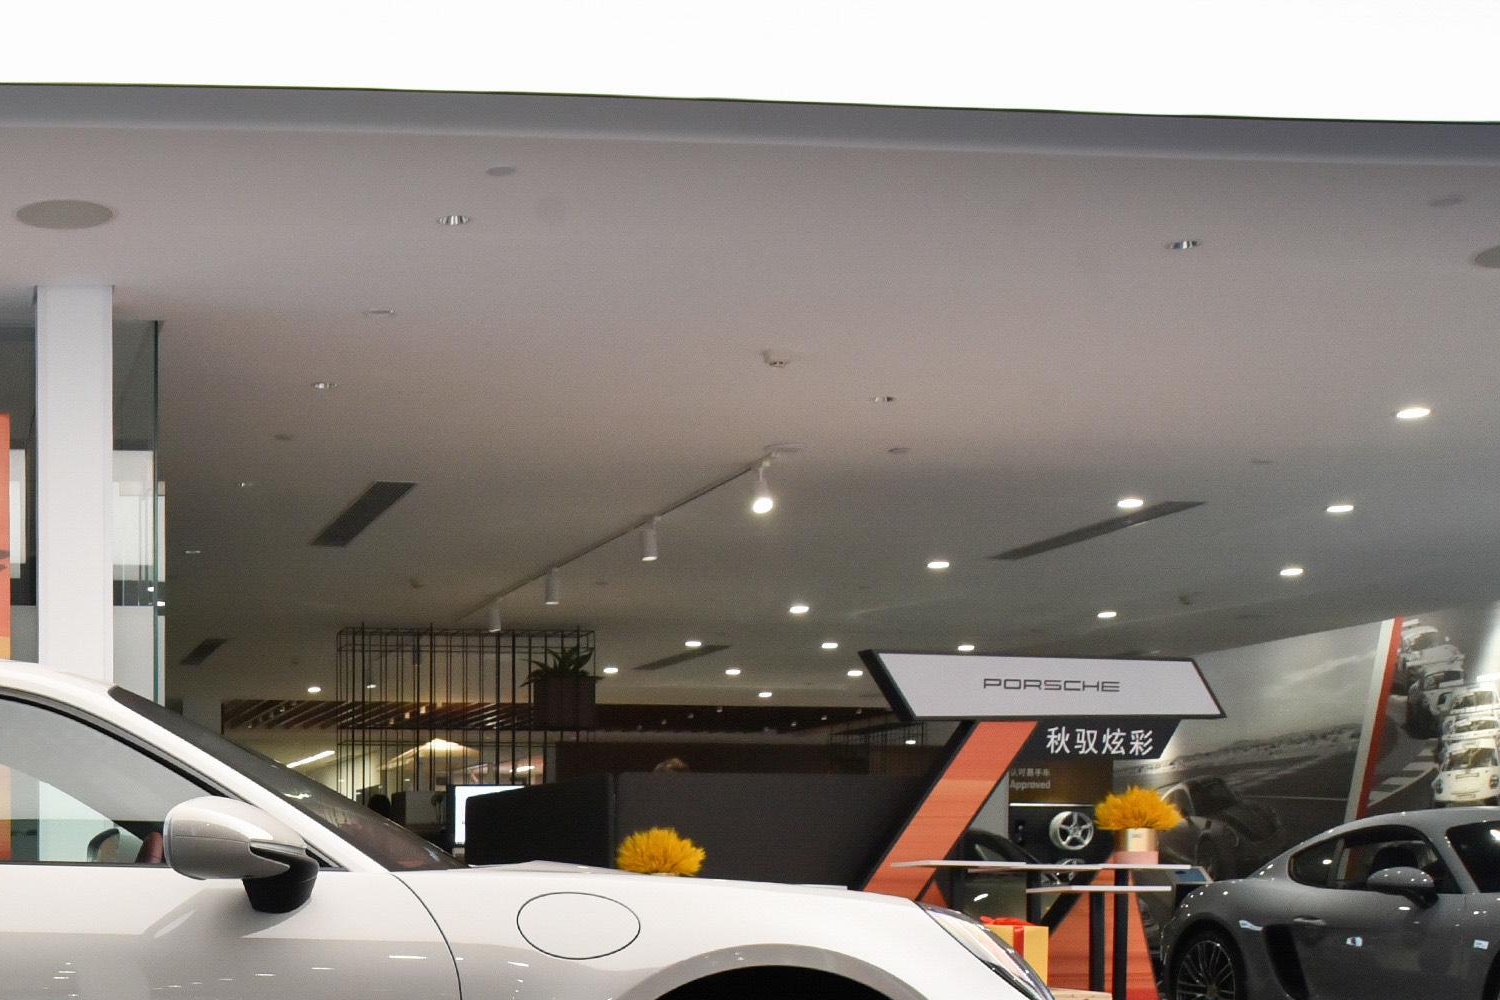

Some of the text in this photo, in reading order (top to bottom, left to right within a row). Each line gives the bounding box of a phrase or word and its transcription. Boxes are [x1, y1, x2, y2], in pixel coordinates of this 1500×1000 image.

[983, 678, 1120, 692] PORSCHE
[1046, 725, 1154, 756] 秋驭炫彩
[1010, 779, 1051, 791] Approved
